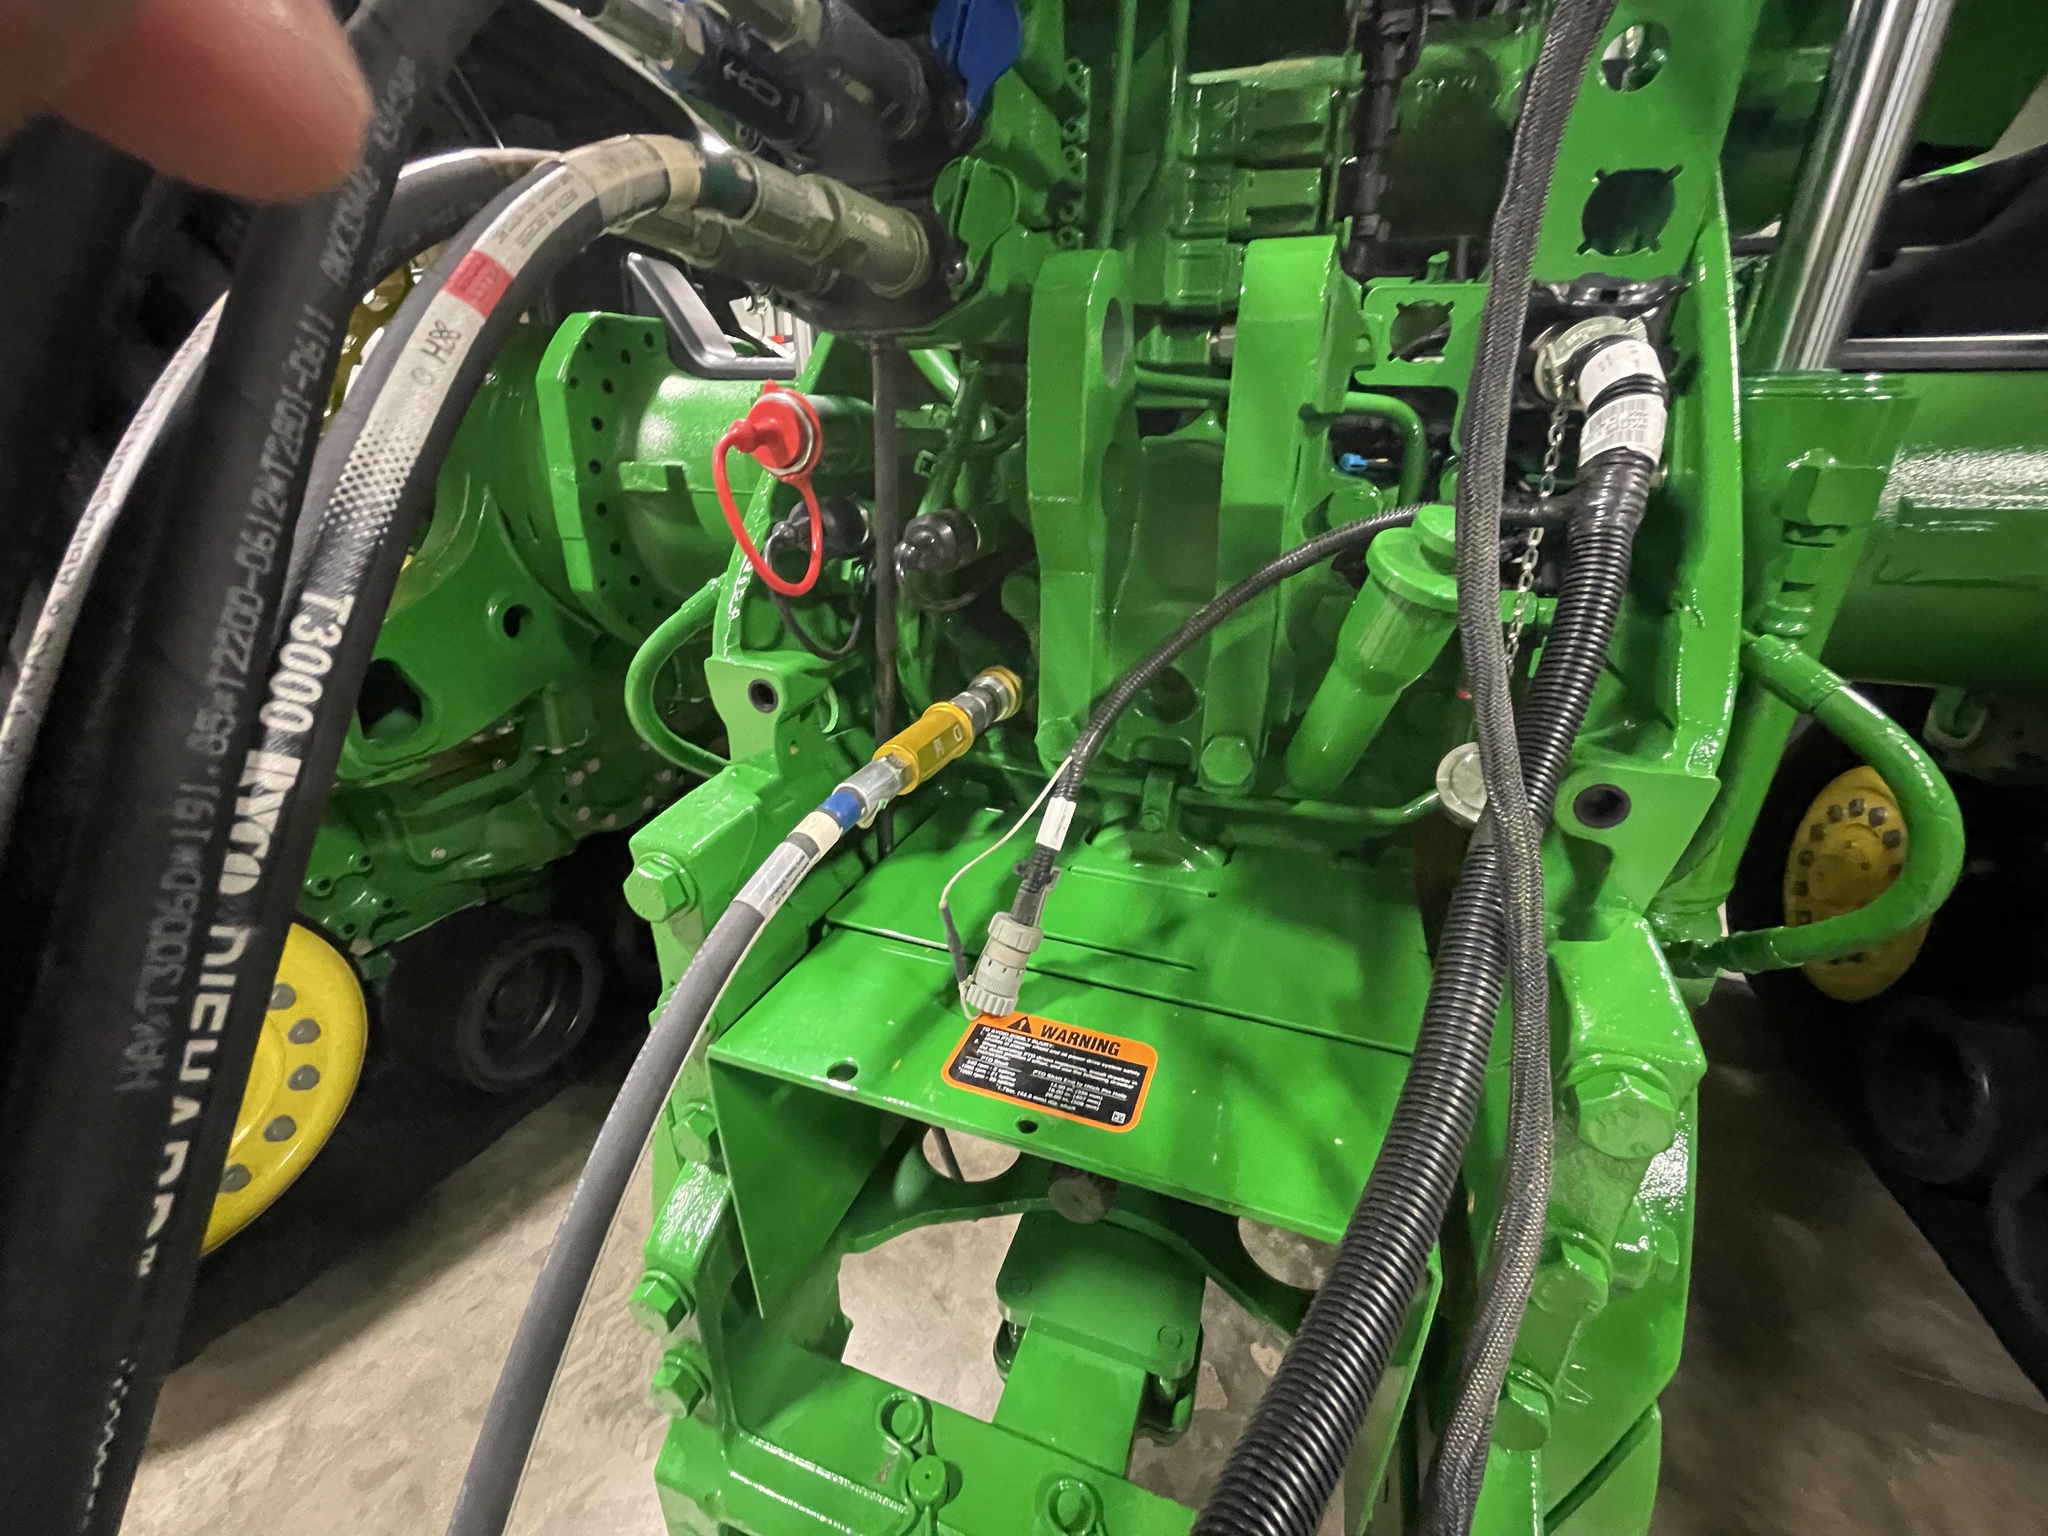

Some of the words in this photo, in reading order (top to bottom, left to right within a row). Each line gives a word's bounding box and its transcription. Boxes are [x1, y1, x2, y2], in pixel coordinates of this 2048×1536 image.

[259, 591, 355, 733] T3000
[990, 1028, 1009, 1037] AVOID
[1038, 1024, 1122, 1056] WARNING
